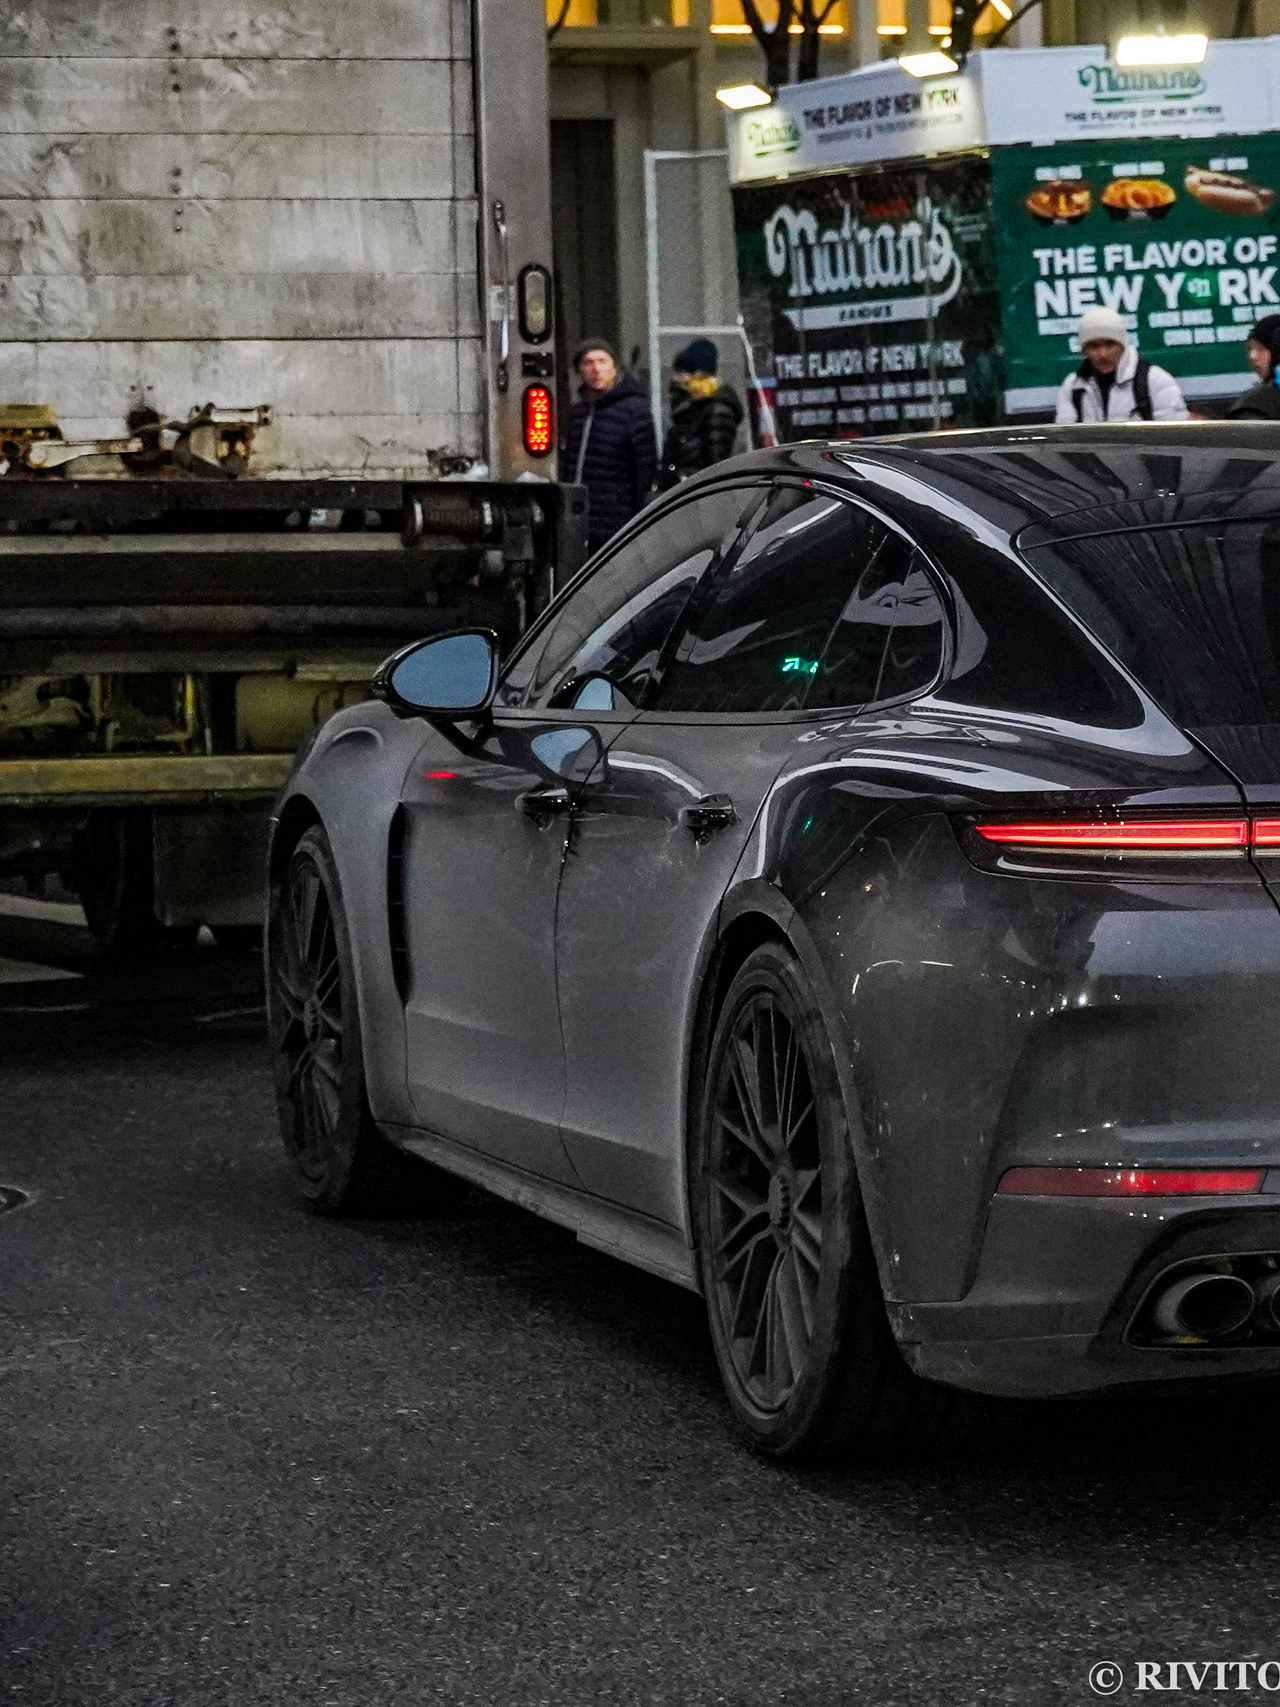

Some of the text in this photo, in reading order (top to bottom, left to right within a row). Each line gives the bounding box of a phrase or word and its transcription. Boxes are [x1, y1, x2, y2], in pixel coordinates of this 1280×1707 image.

[1033, 235, 1278, 276] THE FLAVOR OF
[1034, 274, 1145, 318] NEW
